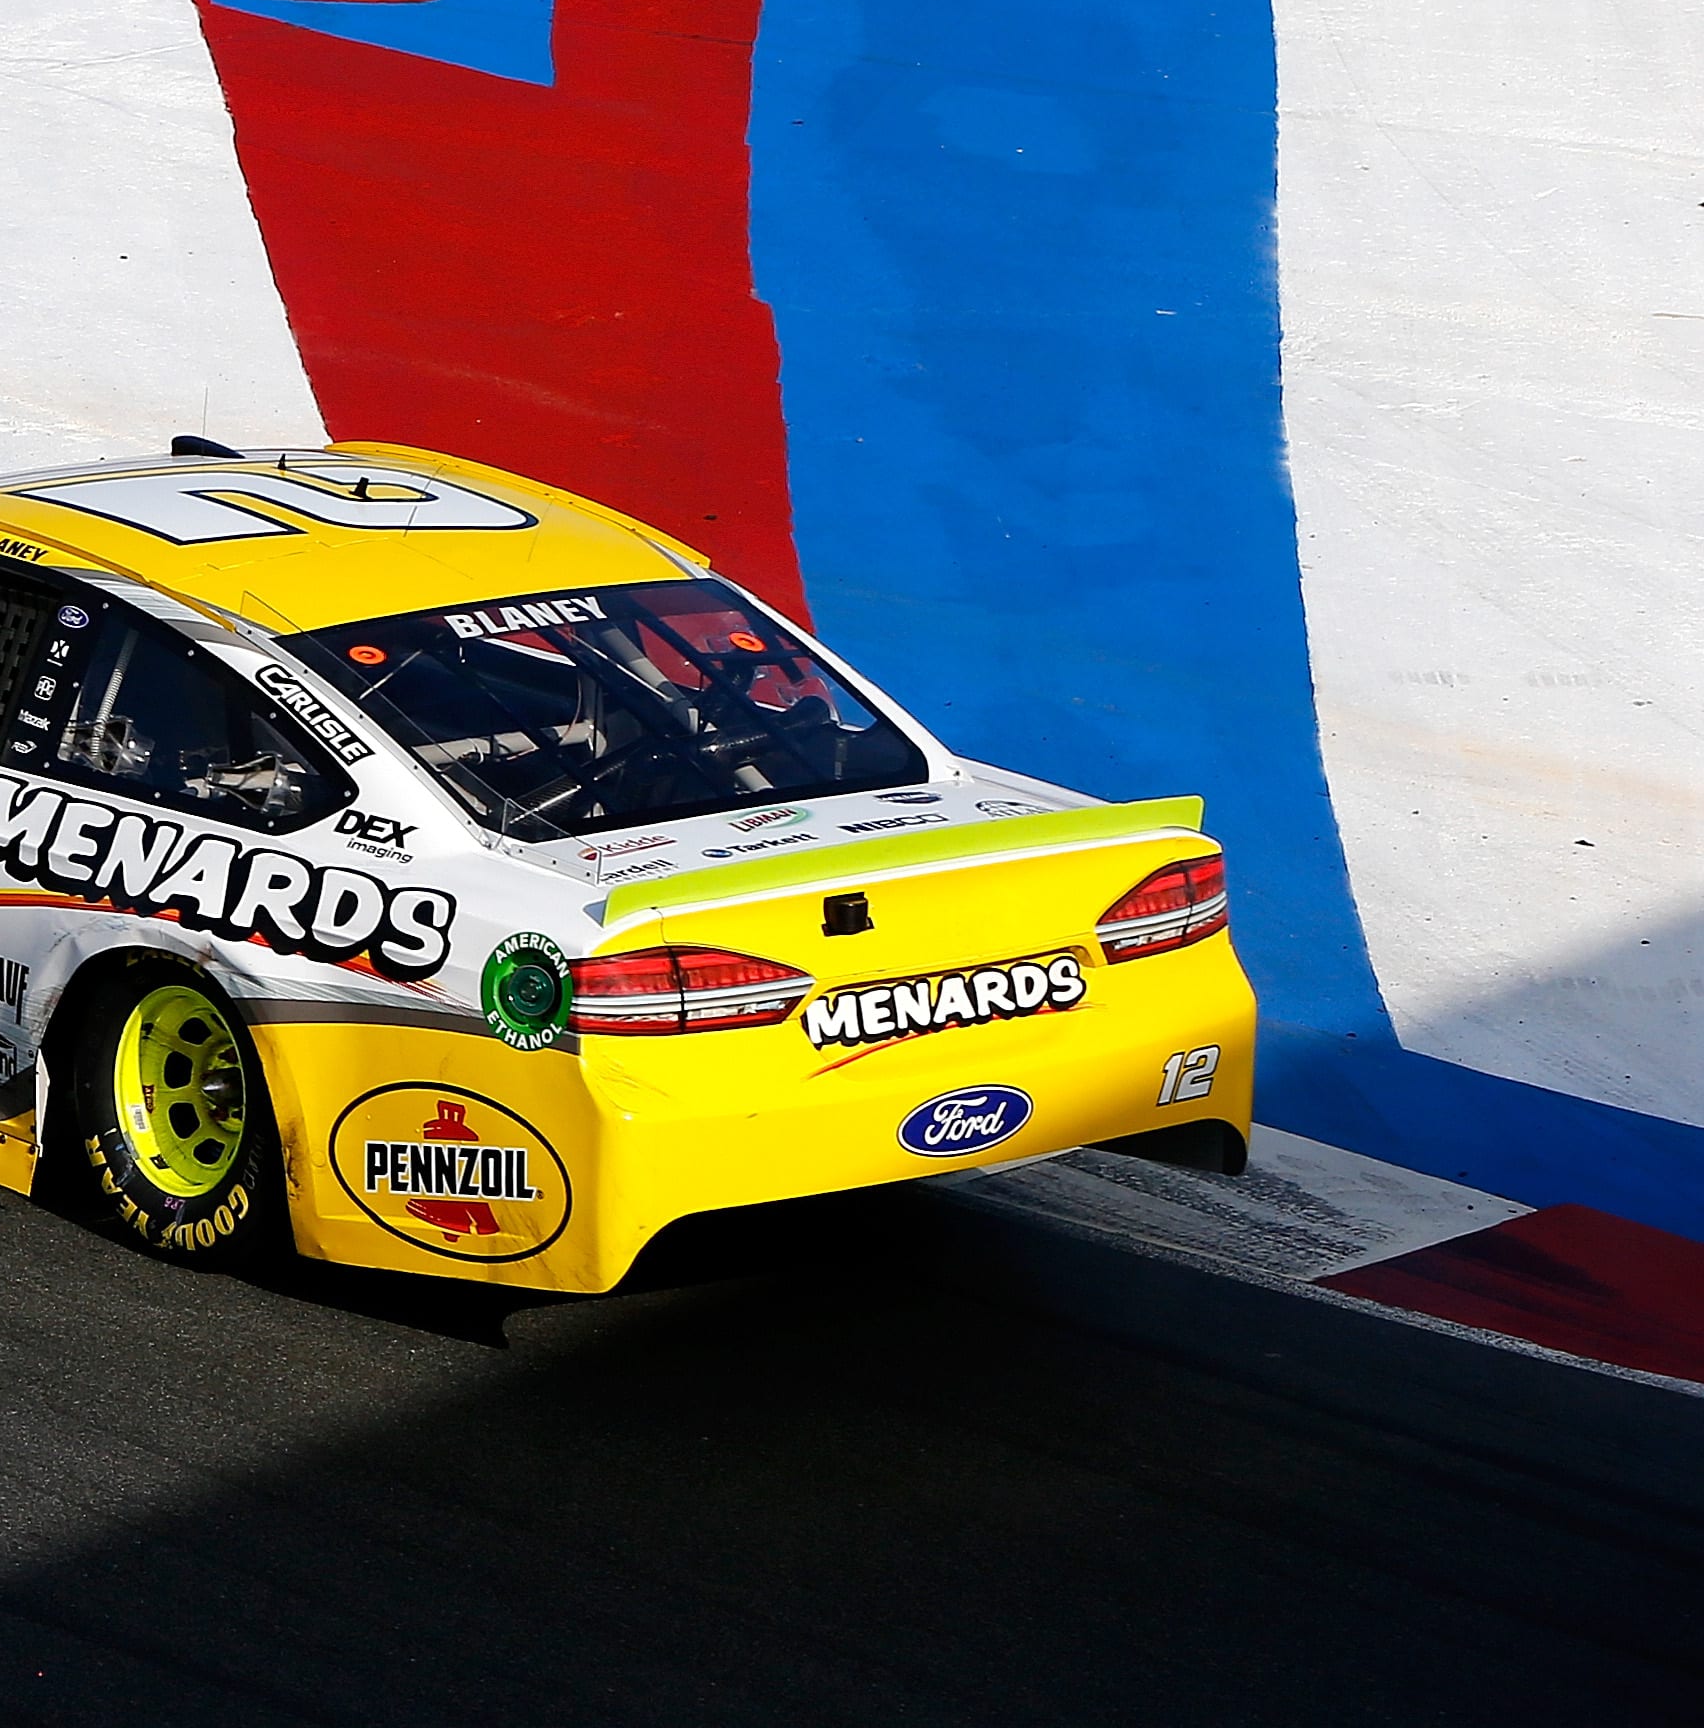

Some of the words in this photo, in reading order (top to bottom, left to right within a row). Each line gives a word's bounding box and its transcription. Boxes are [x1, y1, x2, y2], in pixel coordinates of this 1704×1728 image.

[445, 596, 609, 638] BLANEY
[259, 667, 367, 764] CARLISLE
[334, 809, 419, 849] DEX
[728, 808, 798, 832] LIBMAN
[838, 813, 949, 834] NIBCO
[346, 838, 414, 864] imaging
[599, 834, 669, 853] Kidde
[729, 832, 819, 853] Tarkett
[494, 934, 569, 978] AMERICAN
[800, 955, 1086, 1049] MENARDS
[487, 1010, 562, 1049] ETHANOL
[1156, 1044, 1220, 1107] 12
[925, 1094, 1006, 1145] Ford
[365, 1141, 536, 1201] PENNZOIL
